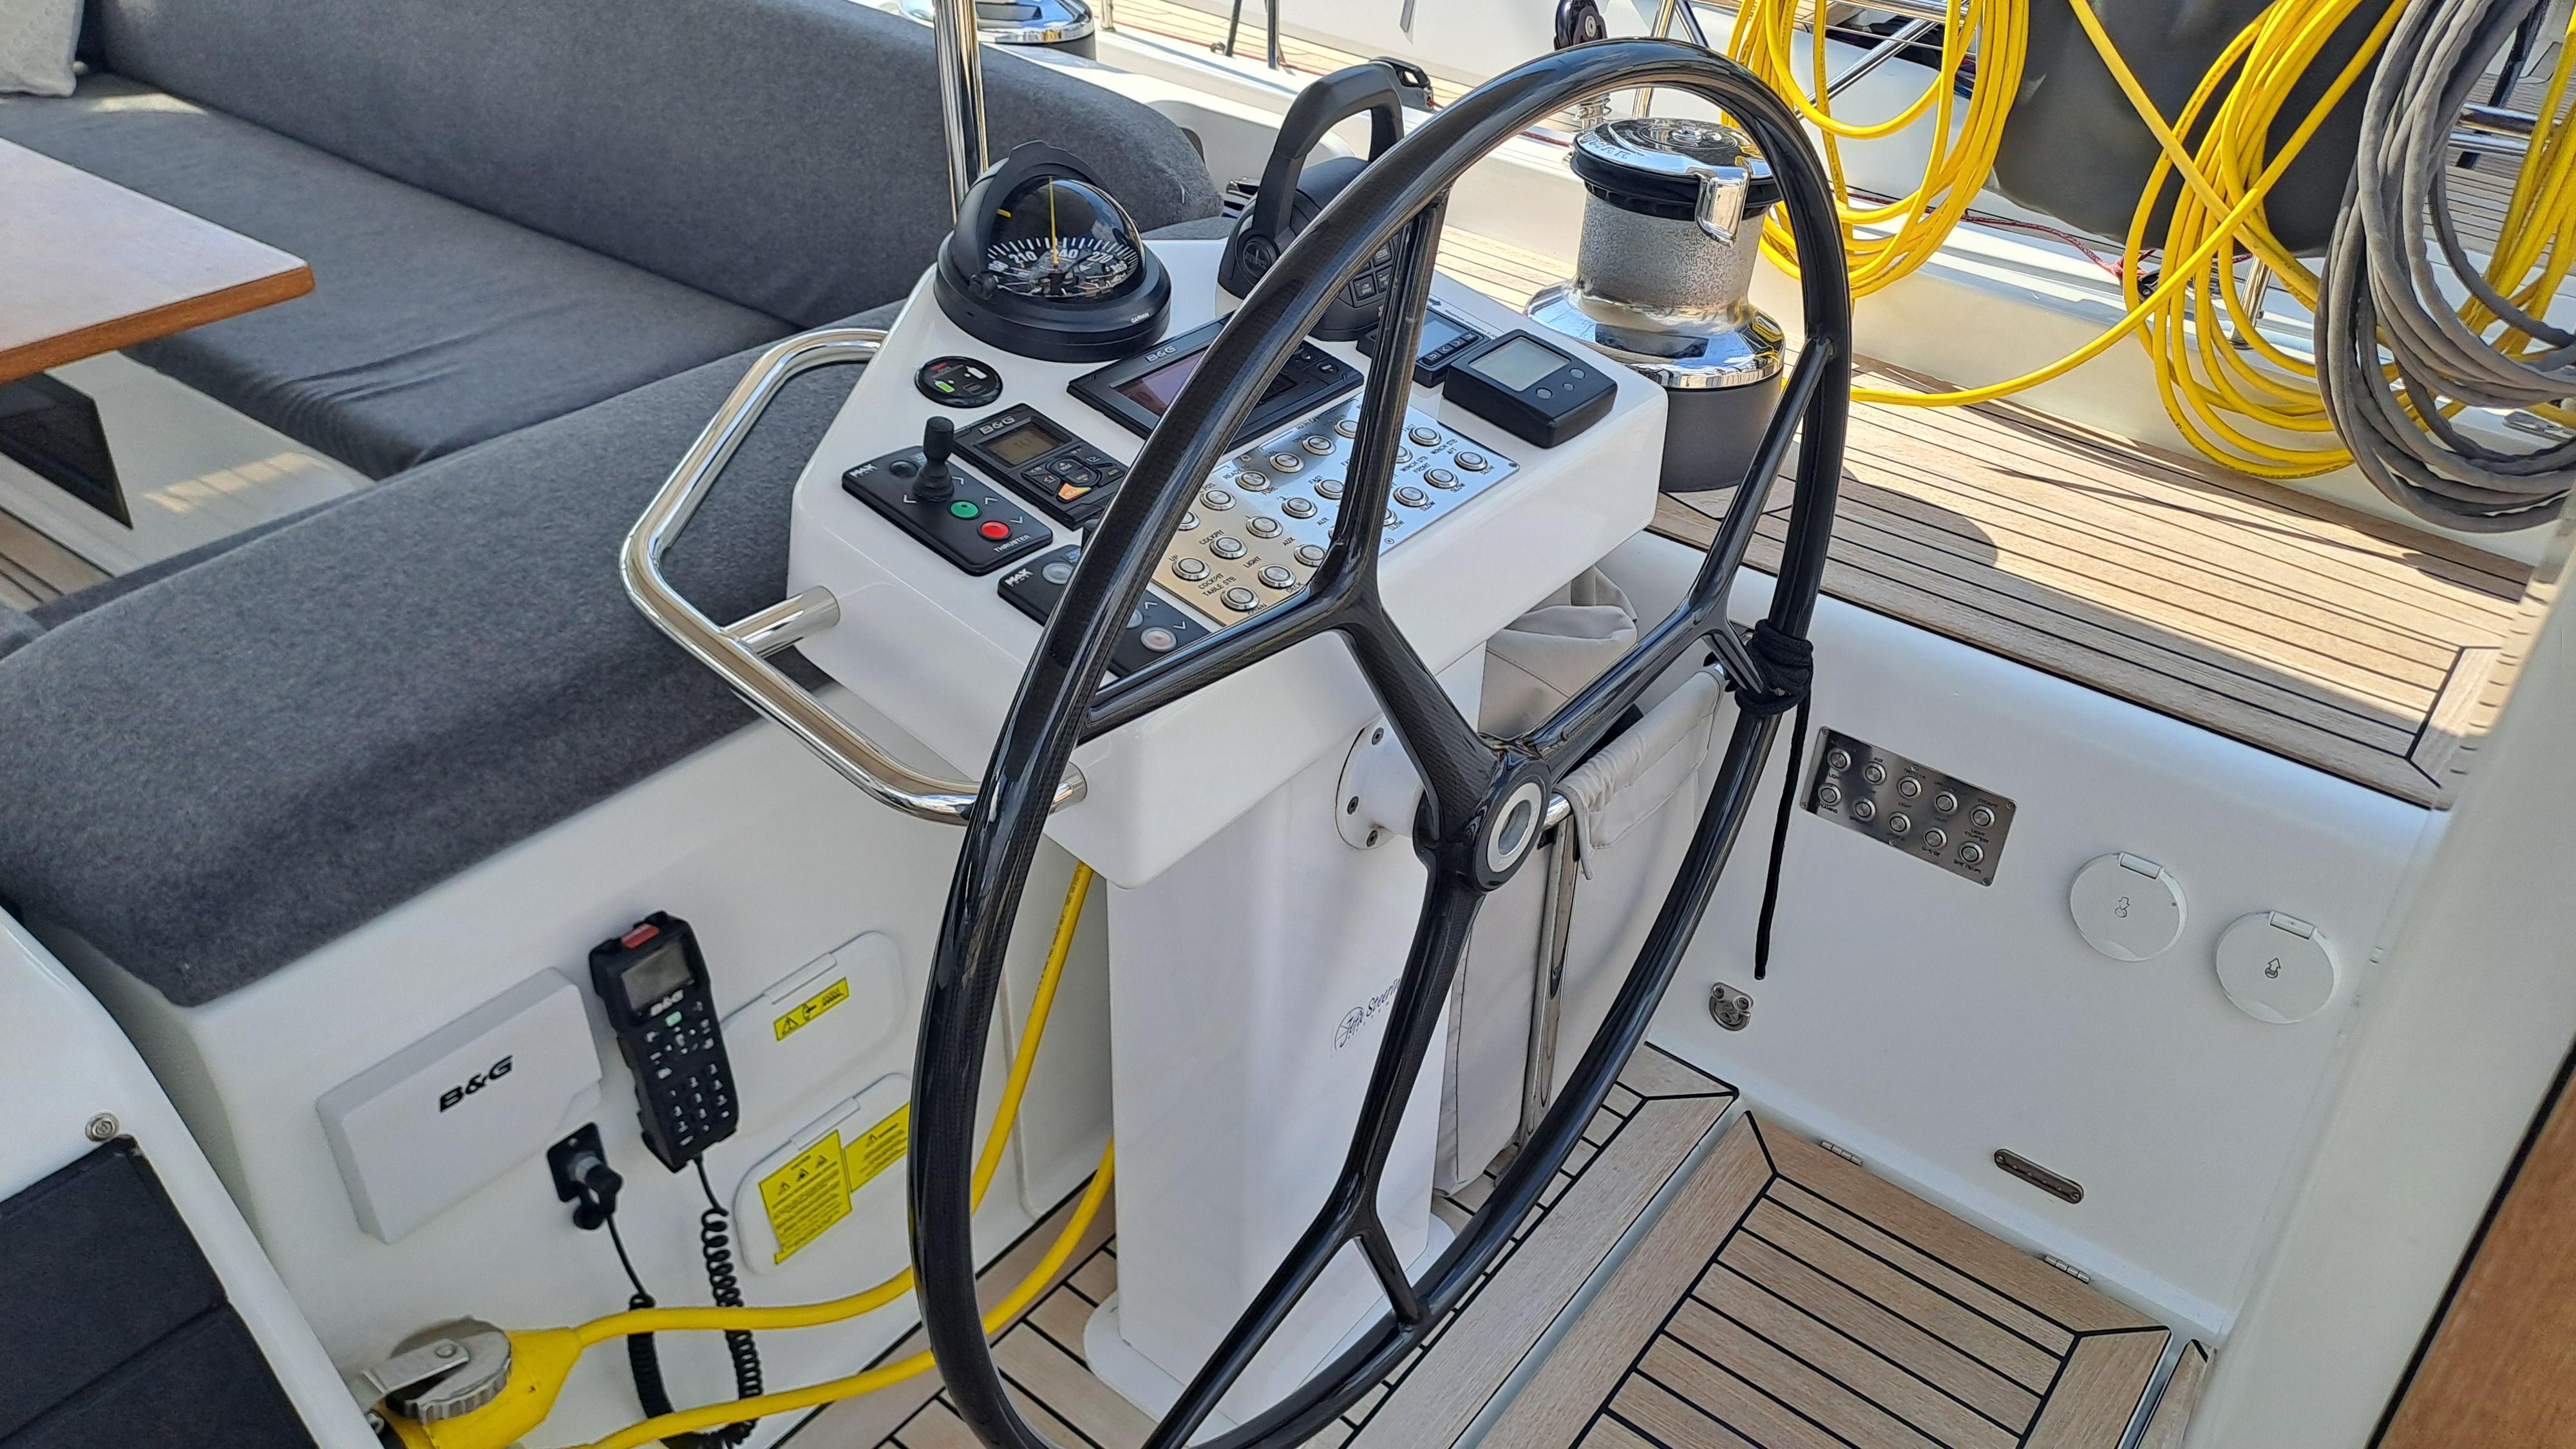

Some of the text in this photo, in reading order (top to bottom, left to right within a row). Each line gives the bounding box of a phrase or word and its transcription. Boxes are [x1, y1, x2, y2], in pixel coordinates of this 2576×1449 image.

[1009, 251, 1037, 264] 210
[1091, 251, 1113, 263] 270
[1130, 312, 1150, 323] GARMIN
[1145, 345, 1177, 363] B&G
[979, 415, 1016, 435] B&G
[849, 463, 878, 477] MAX
[1479, 465, 1495, 475] SLOW
[1450, 482, 1466, 493] SLOW
[1419, 500, 1436, 512] SLOW
[1316, 516, 1331, 526] AUX
[1388, 520, 1405, 531] SLOW
[1198, 529, 1225, 545] COCKPIT
[1283, 536, 1296, 547] AUX
[994, 534, 1031, 554] THRUSTER
[1243, 556, 1263, 569] LIGHT
[1005, 568, 1034, 586] MAX
[1198, 573, 1225, 590] COCKPIT
[1202, 576, 1237, 598] TABLE STB
[1285, 582, 1305, 594] DECK
[650, 989, 684, 1016] B&G
[439, 1055, 513, 1113] B&G
